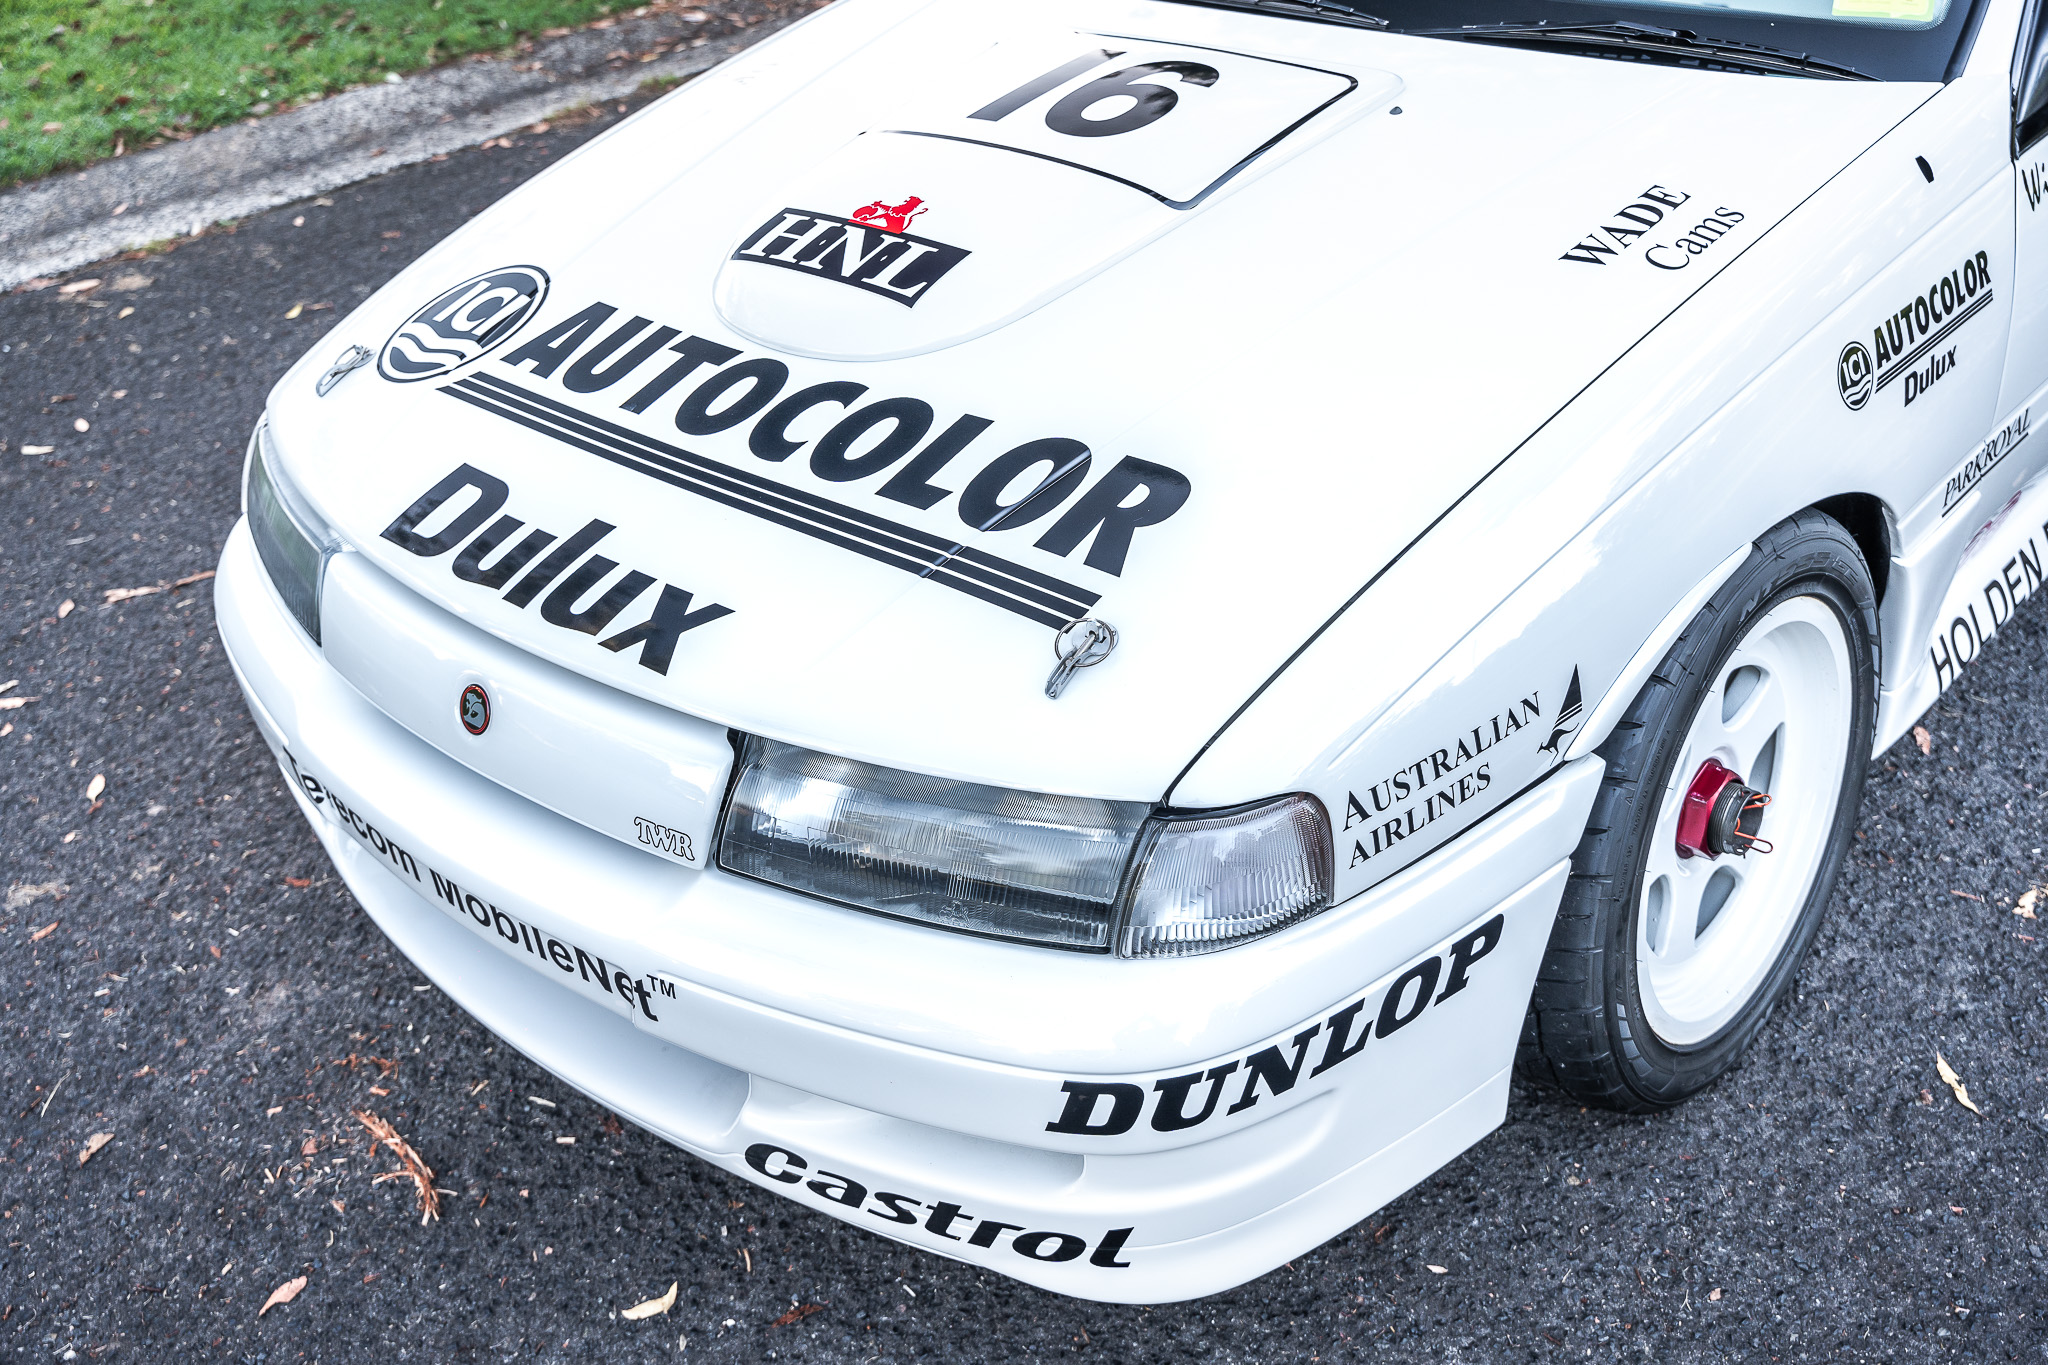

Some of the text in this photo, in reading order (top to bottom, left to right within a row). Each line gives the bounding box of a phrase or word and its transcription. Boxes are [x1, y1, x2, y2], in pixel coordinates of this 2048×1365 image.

[966, 48, 1220, 138] 16
[739, 212, 940, 300] HNL
[1558, 184, 1691, 269] WADE
[1645, 205, 1746, 271] Cams
[432, 280, 532, 337] ICI
[1873, 250, 1992, 371] AUTOCOLOR
[1841, 350, 1867, 388] ICI
[1904, 344, 1957, 408] Dulux
[499, 301, 1192, 578] AUTOCOLOR
[1942, 407, 2031, 508] PARKROYAL
[380, 462, 736, 677] Dulux
[1930, 537, 2042, 694] HOLDEN
[1342, 691, 1542, 832] AUSTRALIAN
[634, 816, 696, 862] TWR
[1348, 762, 1492, 870] AIRLINES
[1044, 913, 1505, 1137] DUNLOP
[744, 1141, 1135, 1269] Castrol
